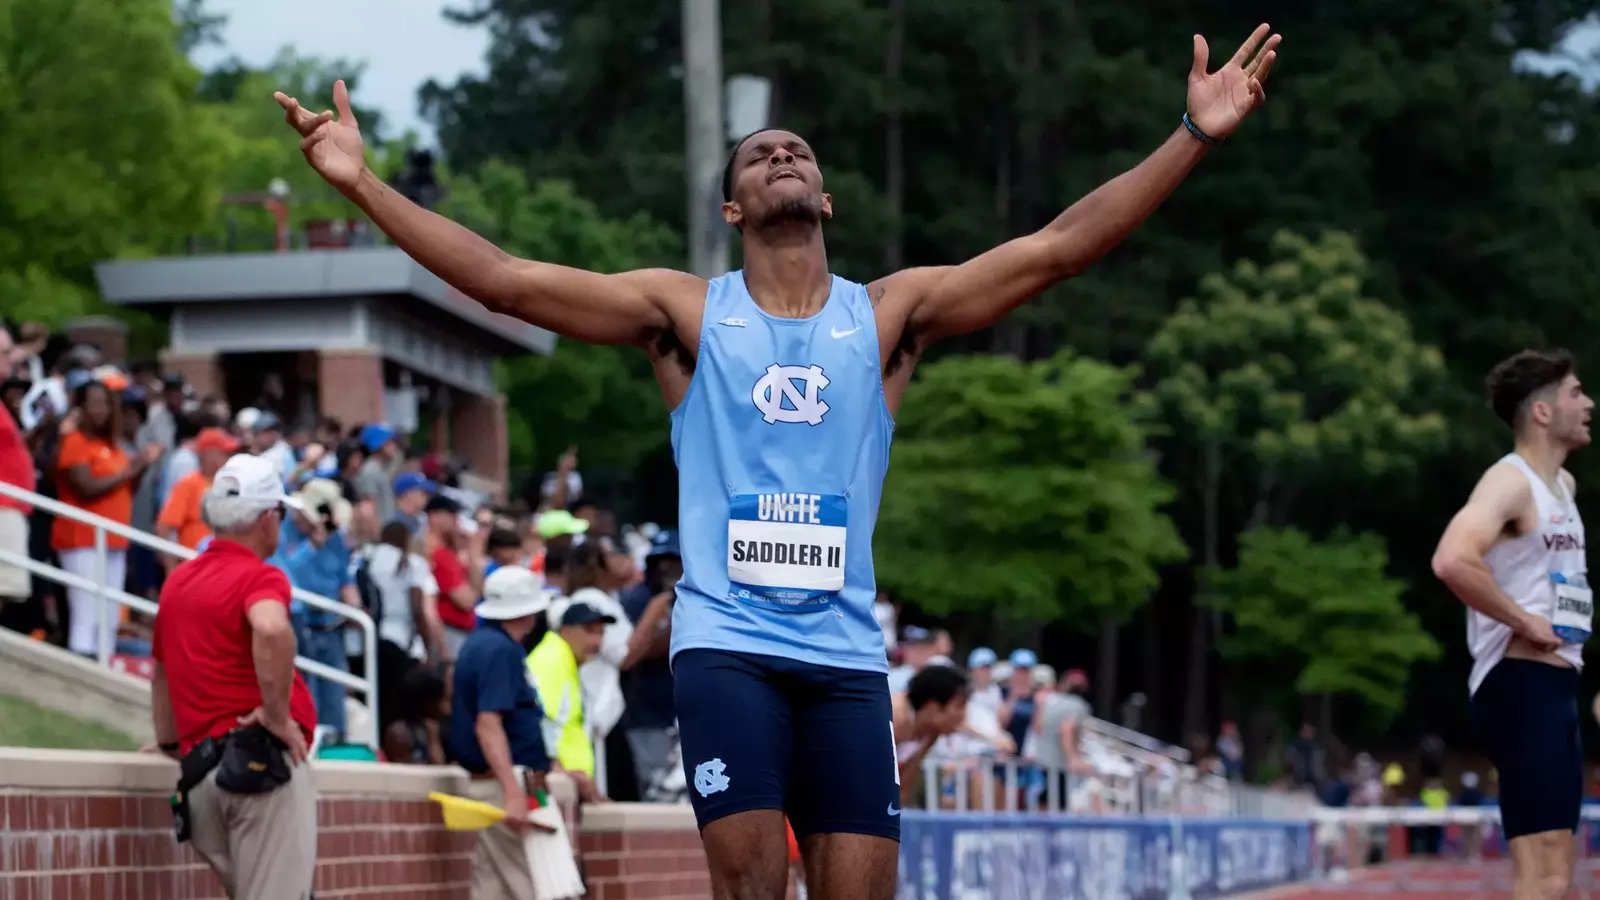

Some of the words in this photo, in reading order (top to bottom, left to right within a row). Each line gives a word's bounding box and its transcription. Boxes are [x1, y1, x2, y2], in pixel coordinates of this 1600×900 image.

[758, 492, 822, 525] UNITE
[732, 539, 823, 567] SADDLER
[827, 546, 841, 569] II
